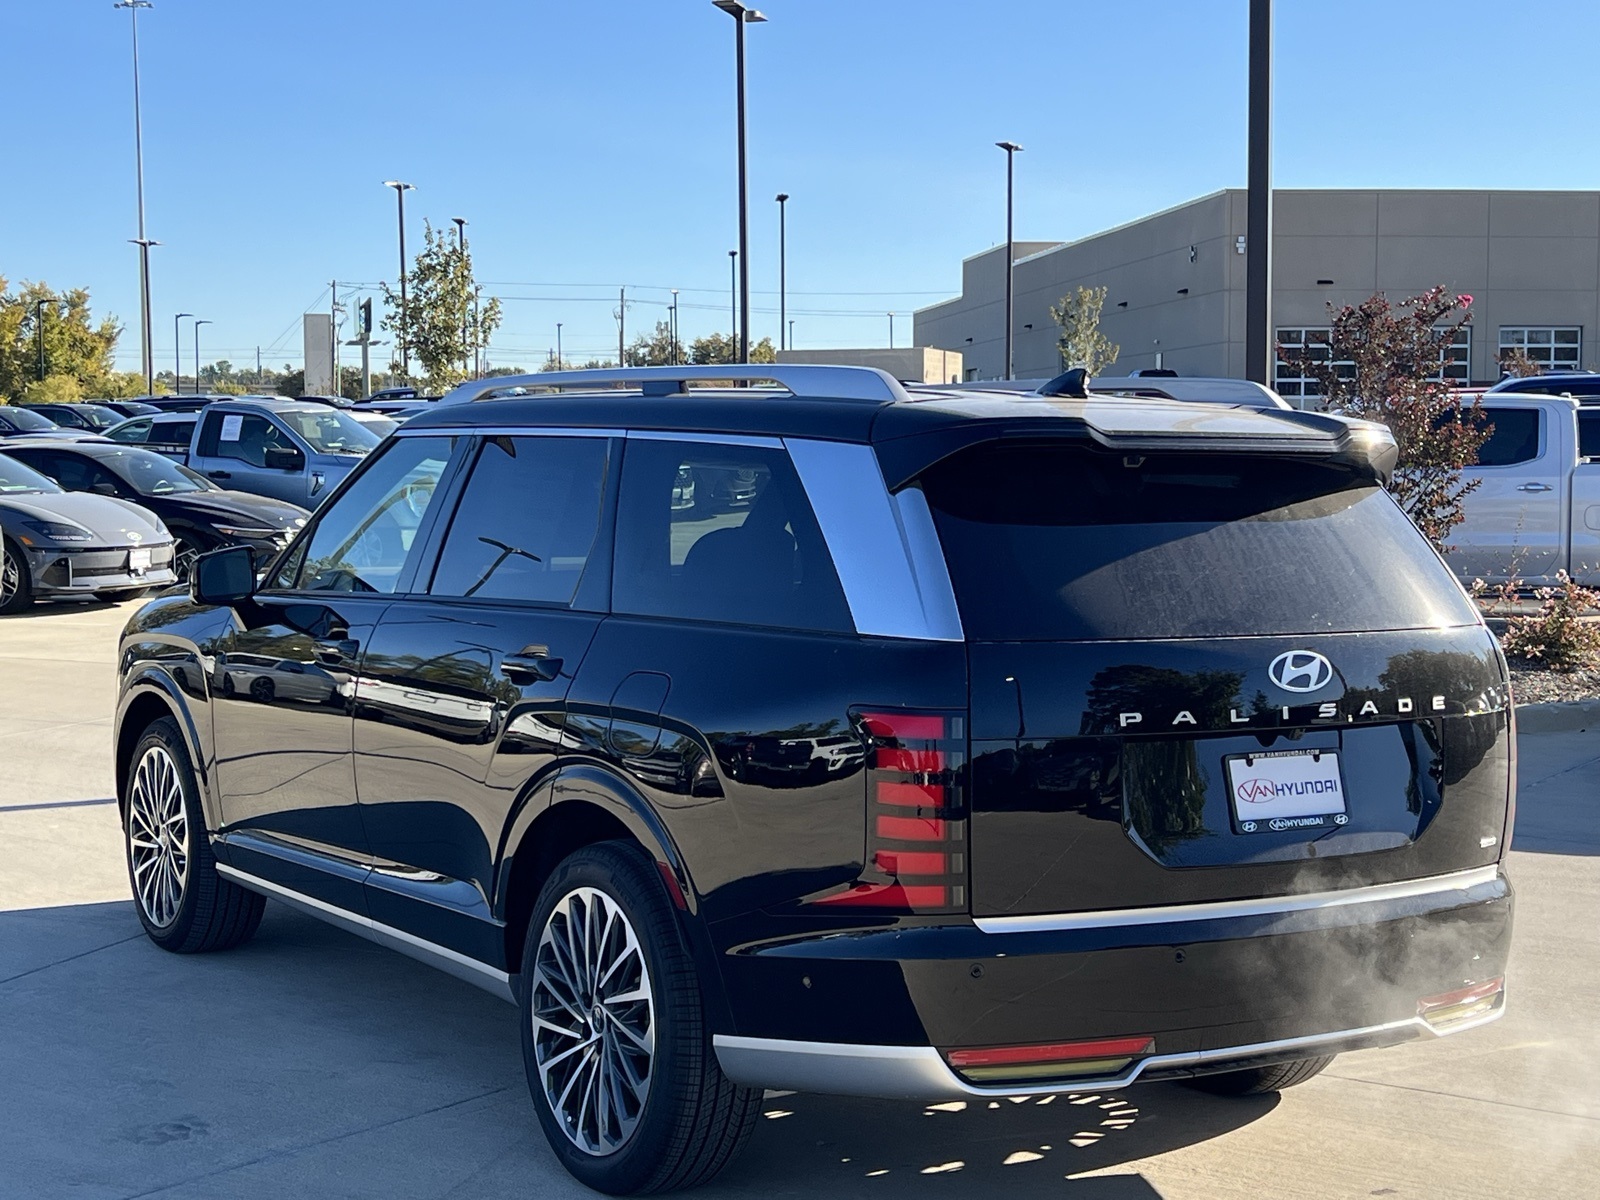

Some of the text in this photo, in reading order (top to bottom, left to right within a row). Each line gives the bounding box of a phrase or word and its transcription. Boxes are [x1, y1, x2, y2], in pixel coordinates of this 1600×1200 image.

[1119, 696, 1445, 727] PALISADE
[1275, 779, 1338, 797] HYUNDAI
[1286, 817, 1324, 827] HYUNDAI
